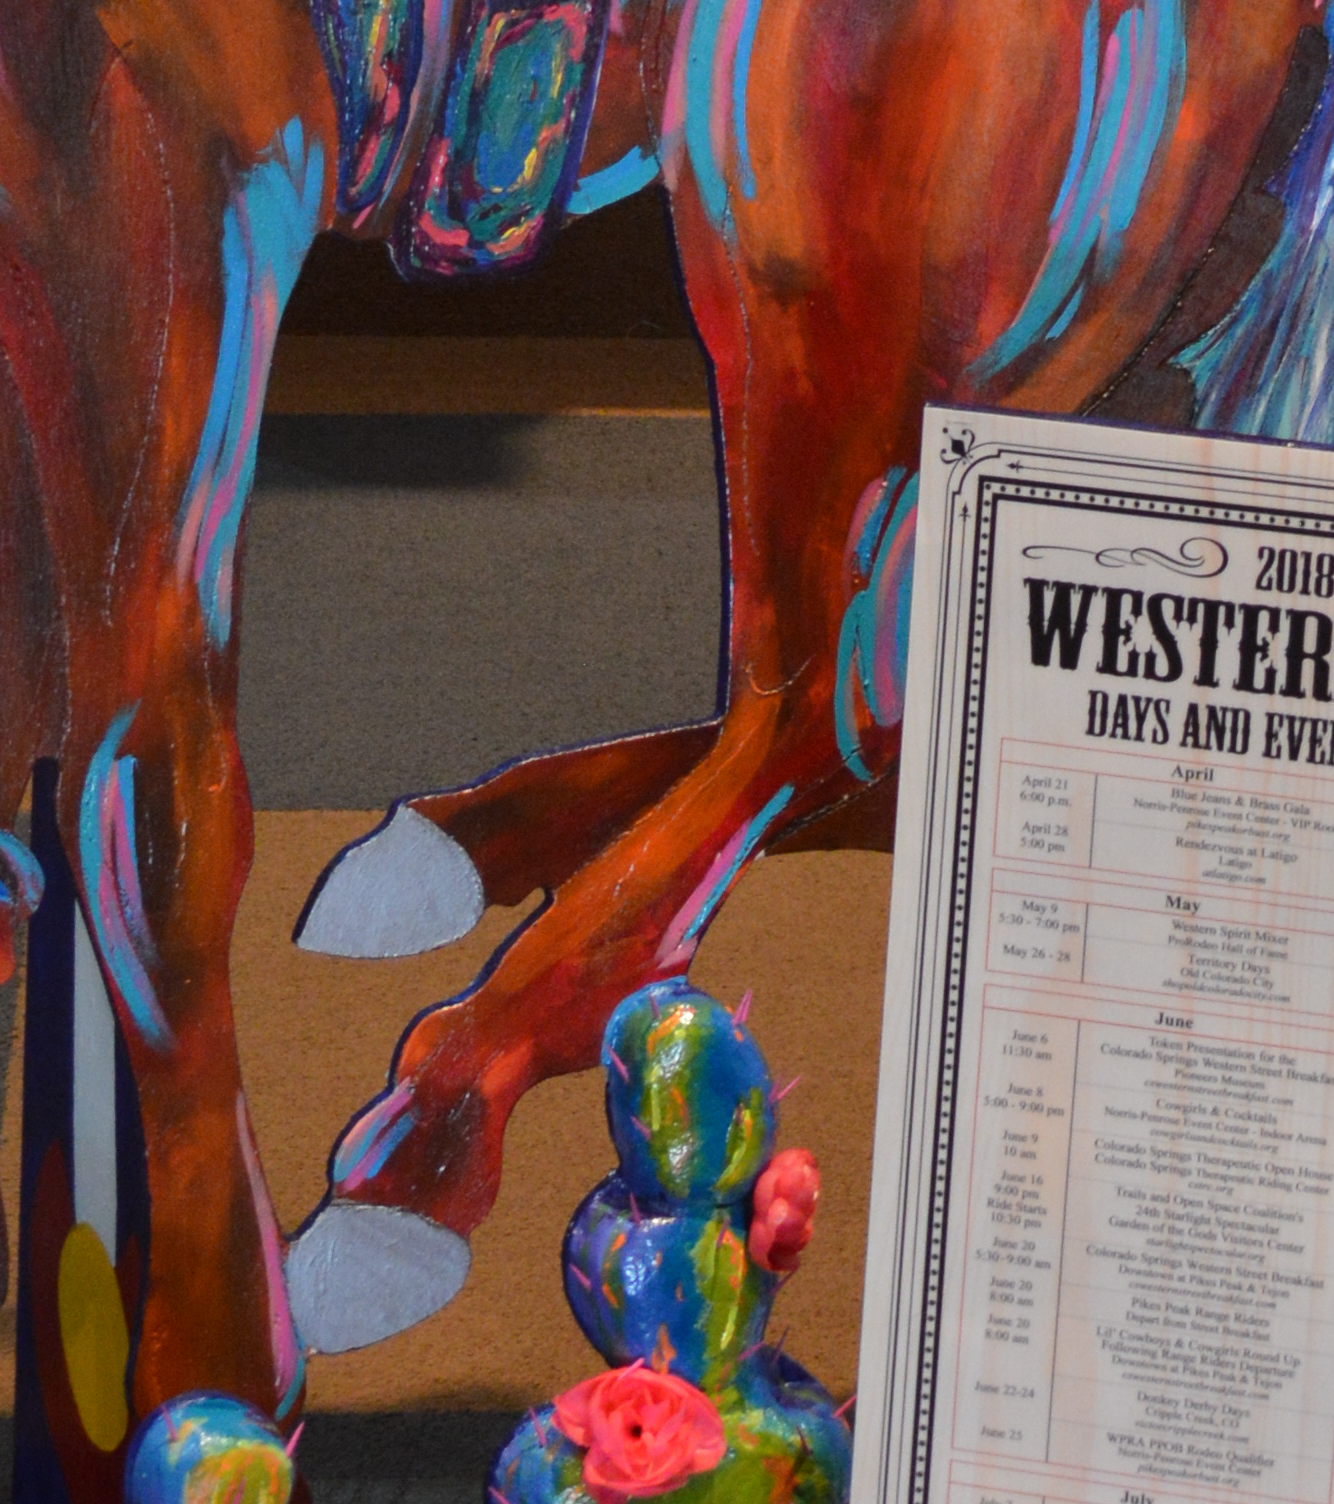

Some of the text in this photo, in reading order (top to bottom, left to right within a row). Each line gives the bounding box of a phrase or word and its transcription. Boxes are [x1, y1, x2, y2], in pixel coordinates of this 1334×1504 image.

[1084, 688, 1171, 746] DAYS
[1178, 701, 1252, 756] AND
[1021, 774, 1069, 791] April 21
[1170, 764, 1215, 783] April
[1018, 789, 1072, 807] 6:00 p.m.
[1170, 786, 1311, 816] Blue Jeans & Brass Gala
[1021, 820, 1069, 838] April 28
[1019, 835, 1066, 854] 5:00 pm
[1174, 835, 1299, 865] Rendezvous at Latigo
[1021, 898, 1048, 916] May
[1165, 894, 1200, 915] May
[1171, 918, 1290, 947] Western Spirit Mixer
[1154, 1010, 1194, 1030] June
[1154, 1097, 1208, 1116] Cowgirls
[1223, 1107, 1278, 1126] Cocktails
